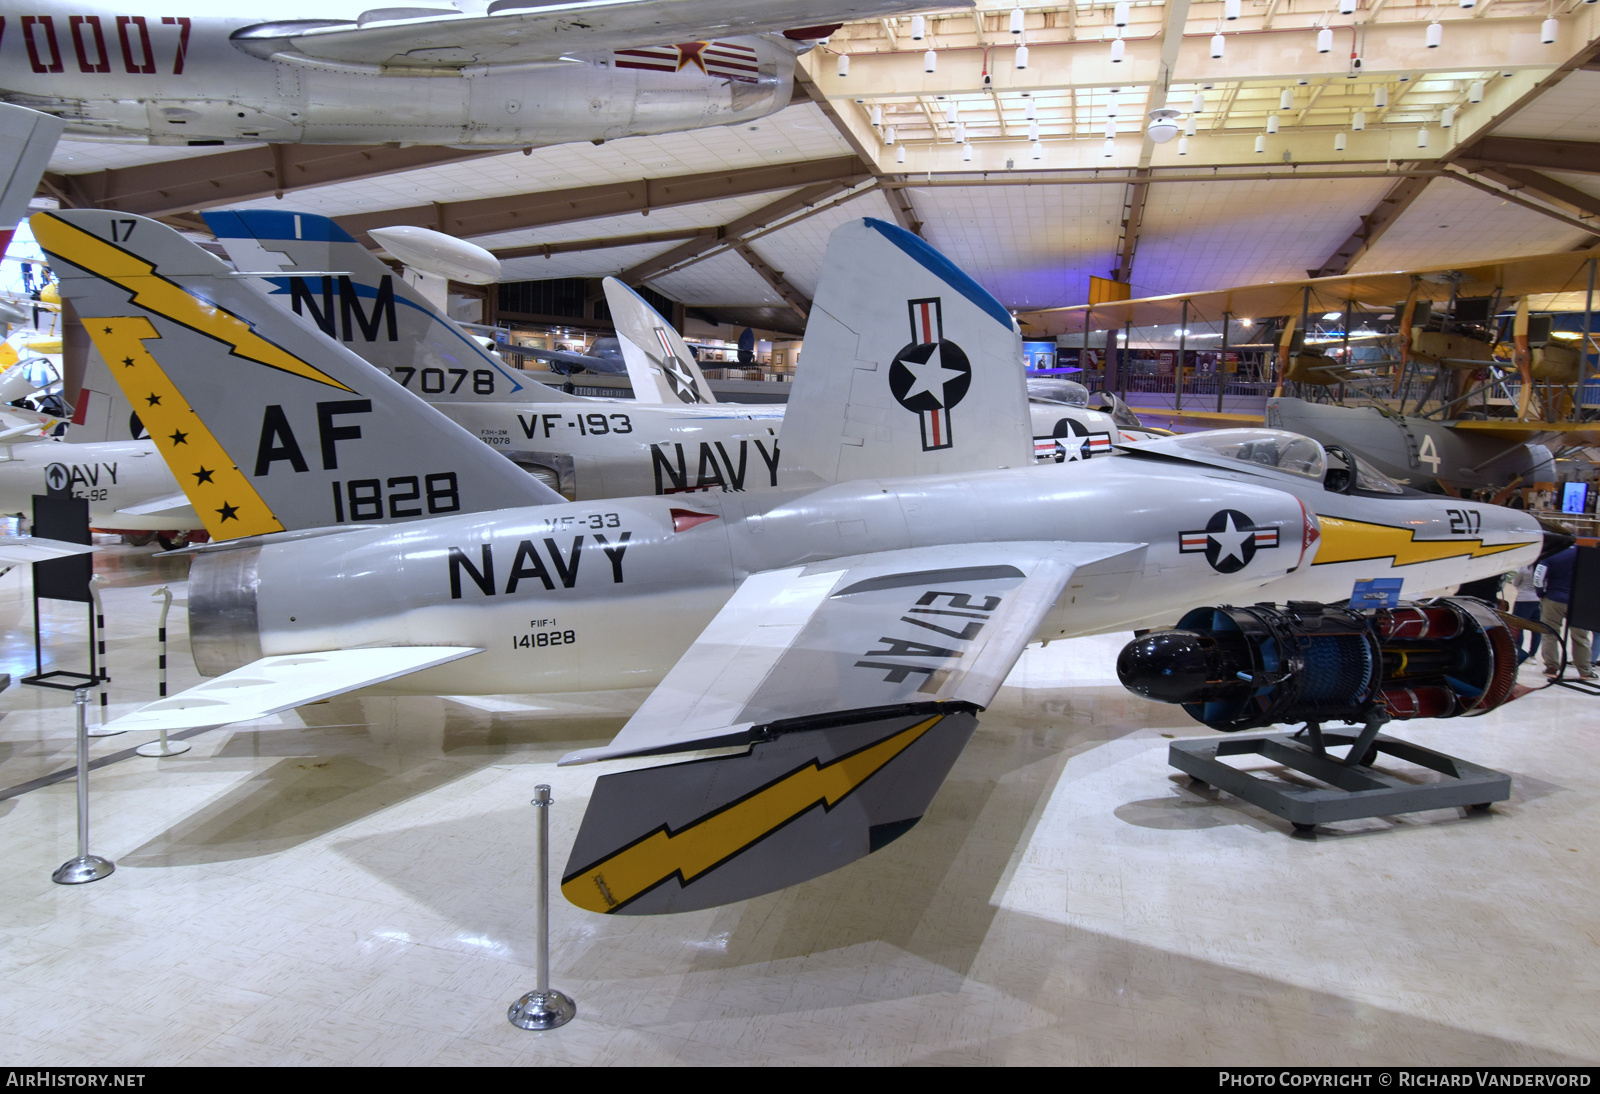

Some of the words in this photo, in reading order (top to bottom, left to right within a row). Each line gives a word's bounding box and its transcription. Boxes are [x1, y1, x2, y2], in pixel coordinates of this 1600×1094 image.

[111, 220, 137, 242] 17
[290, 274, 398, 341] NM
[395, 367, 494, 394] 7078
[254, 399, 372, 476] AF
[517, 414, 633, 439] VF-193
[650, 439, 780, 495] NAVY
[1418, 435, 1441, 473] 4
[45, 462, 117, 487] AVY
[332, 472, 460, 522] 1828
[544, 513, 620, 532] VF-33
[1447, 510, 1481, 534] 217
[448, 532, 632, 599] NAVY
[513, 630, 575, 649] 141828
